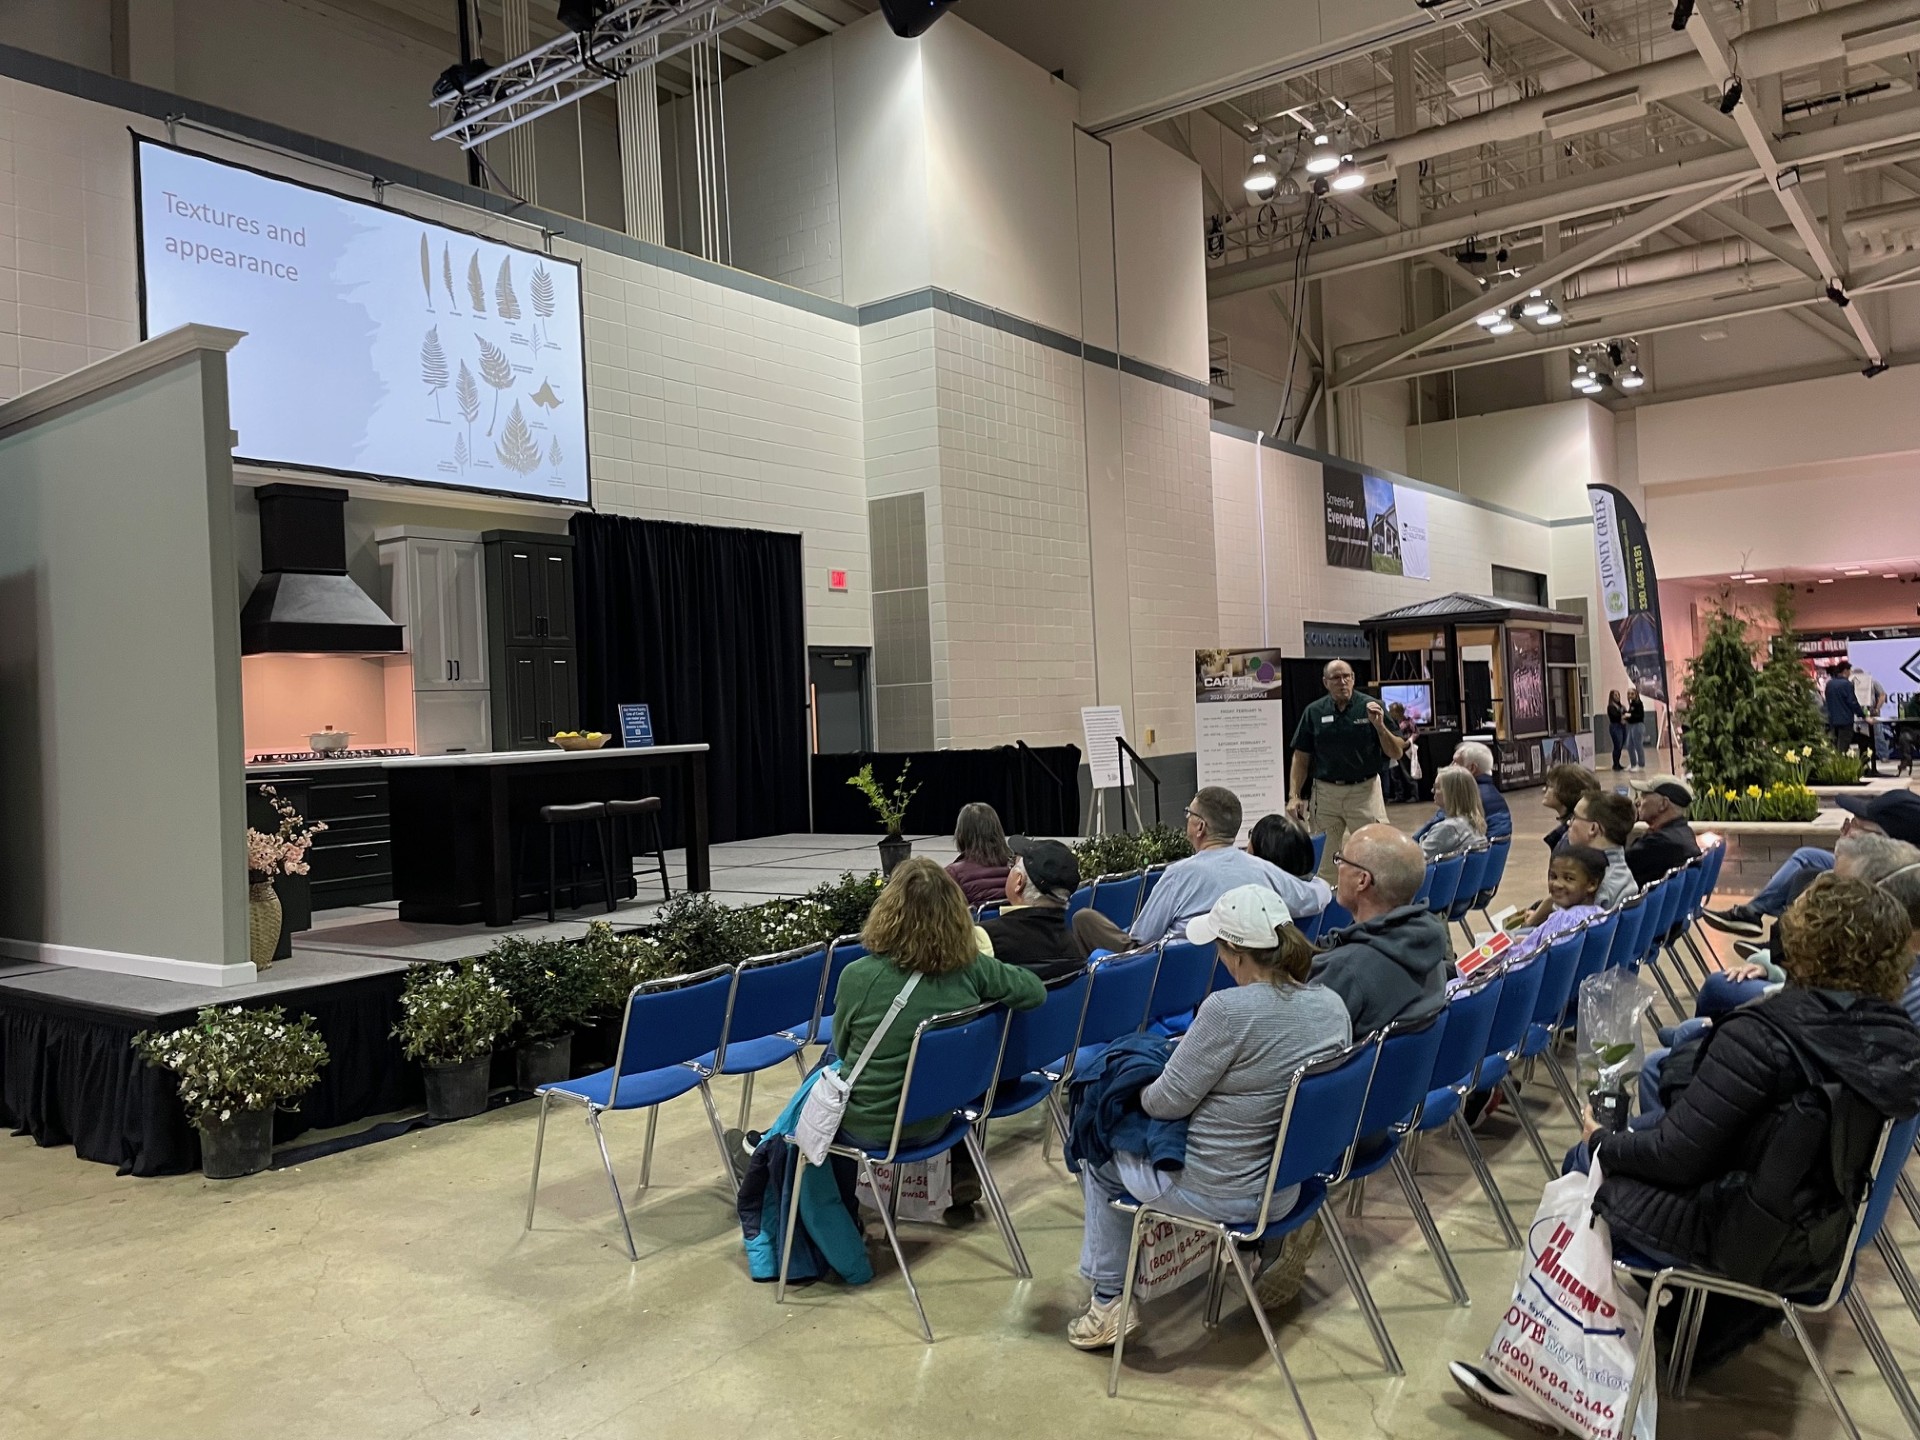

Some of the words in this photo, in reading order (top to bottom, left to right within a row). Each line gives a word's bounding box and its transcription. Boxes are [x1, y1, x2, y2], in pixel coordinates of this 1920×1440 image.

[162, 191, 260, 235] Textures
[266, 224, 306, 248] and
[165, 236, 299, 282] appearance
[1326, 492, 1345, 508] Screens
[1345, 496, 1354, 509] For
[1594, 495, 1609, 537] CREEK
[1327, 507, 1366, 529] Everywhere
[1599, 540, 1616, 589] STONEY
[1204, 676, 1253, 688] CARTER
[1242, 691, 1268, 700] SCHEDULE
[1497, 1335, 1534, 1374] (800)
[1545, 1336, 1573, 1364] My
